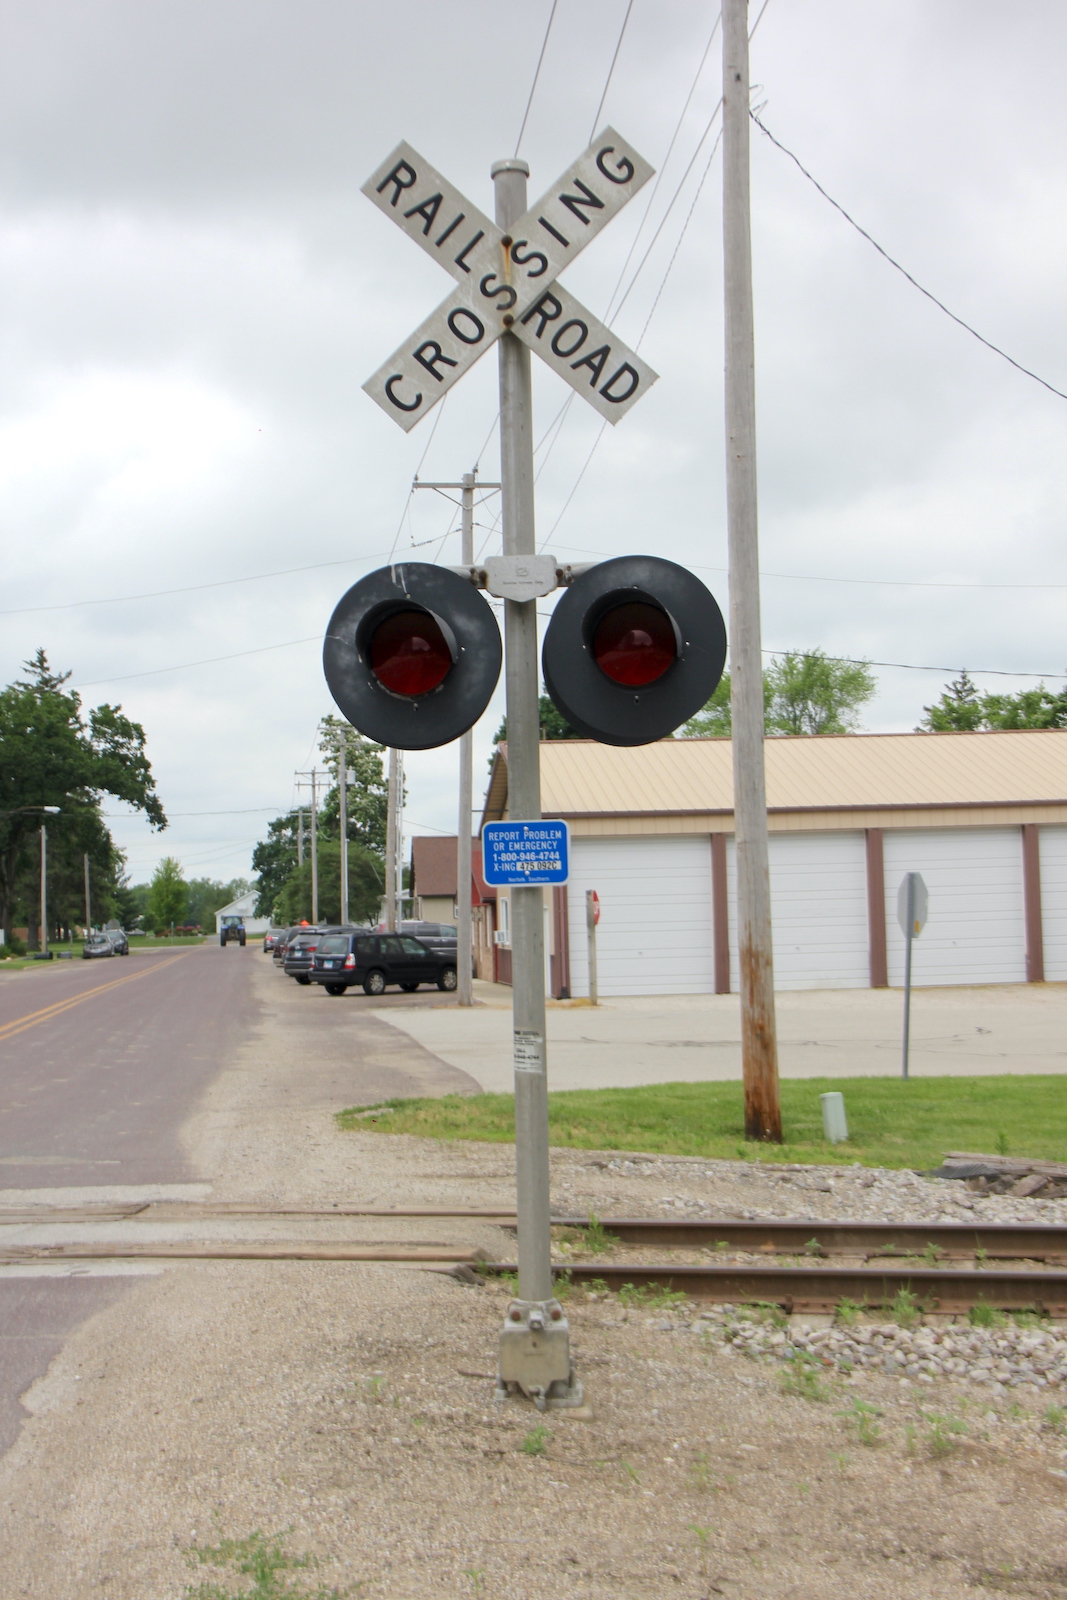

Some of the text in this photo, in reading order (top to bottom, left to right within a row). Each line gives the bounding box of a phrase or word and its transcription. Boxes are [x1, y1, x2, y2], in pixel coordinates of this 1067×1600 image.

[376, 158, 640, 404] RAIL ROAD
[384, 145, 635, 412] CROSSING
[488, 830, 562, 841] REPORT PROBLEM
[493, 840, 558, 851] OR EMERGENCY
[493, 851, 560, 861] 1-800-946-4744
[493, 861, 557, 871] X-ING 475 092C
